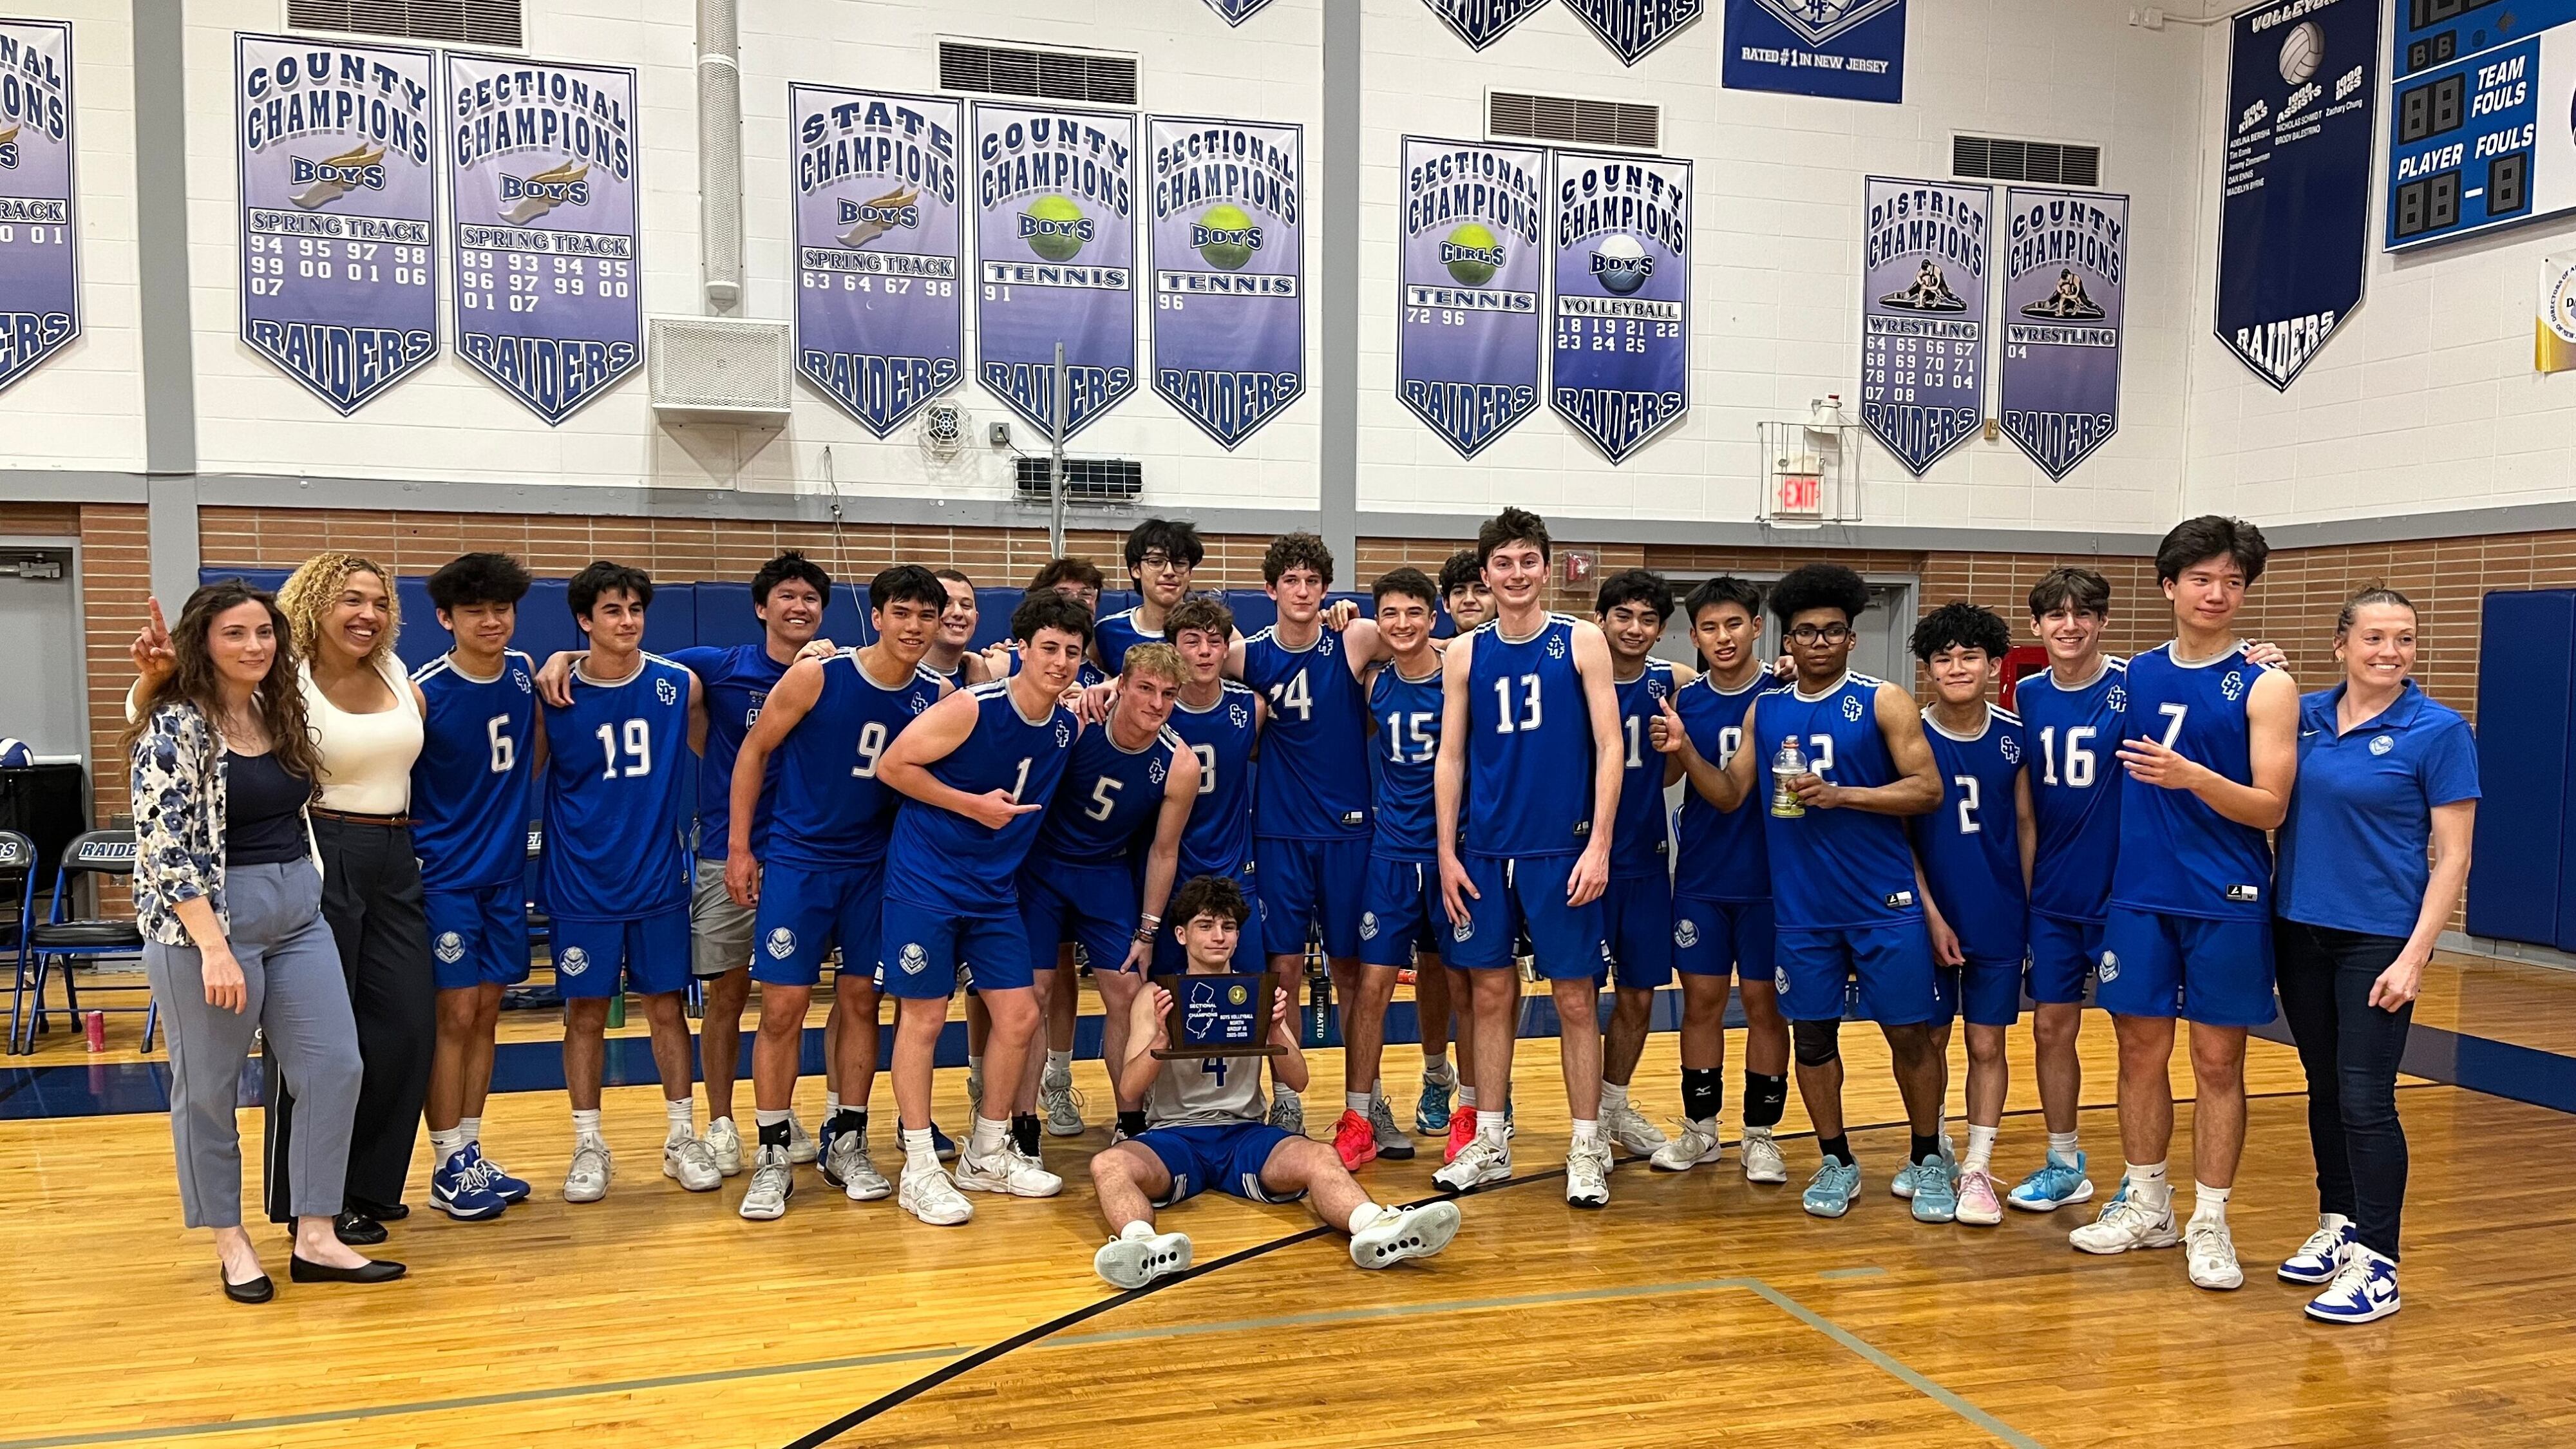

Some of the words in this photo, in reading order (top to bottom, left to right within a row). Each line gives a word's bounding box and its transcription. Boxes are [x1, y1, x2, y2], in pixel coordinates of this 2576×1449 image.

[1742, 47, 1778, 62] RATED
[1781, 48, 1797, 66] #1
[1799, 53, 1812, 66] IN
[1814, 54, 1843, 69] NEW
[1846, 57, 1888, 73] JERSEY
[2478, 55, 2525, 90] TEAM
[247, 52, 426, 111] COUNTY
[2289, 82, 2312, 106] 1000
[2336, 66, 2362, 90] 1000
[2336, 76, 2361, 100] DIGS
[458, 70, 627, 133] SECTIONAL
[2277, 86, 2322, 123] ASSISTS
[2472, 82, 2526, 117] FOULS
[247, 90, 427, 164] CHAMPIONS
[802, 102, 952, 159] STATE
[2239, 106, 2268, 133] KILLS
[457, 106, 630, 182] CHAMPIONS
[981, 118, 1128, 170] COUNTY
[1157, 129, 1294, 182] SECTIONAL
[2398, 144, 2463, 180] PLAYER
[2475, 124, 2534, 159] FOULS
[290, 156, 386, 190] BOYS
[800, 136, 955, 204] CHAMPIONS
[981, 151, 1128, 216] CHAMPIONS
[1411, 151, 1537, 203] SECTIONAL
[1562, 164, 1683, 210] COUNTY
[498, 172, 589, 206] BOYS
[1156, 164, 1296, 226] CHAMPIONS
[252, 211, 343, 236] SPRING
[345, 217, 426, 242] TRACK
[837, 198, 918, 229] BOYS
[1018, 212, 1094, 242] BOYS
[1408, 184, 1537, 245] CHAMPIONS
[1559, 196, 1683, 255] CHAMPIONS
[1871, 190, 1983, 236] DISTRICT
[2012, 200, 2121, 243] COUNTY
[31, 226, 62, 244] 01
[251, 236, 283, 254] 94
[299, 239, 330, 258] 95
[346, 243, 379, 261] 97
[394, 246, 426, 265] 98
[464, 227, 549, 250] SPRING
[554, 234, 629, 257] TRACK
[1190, 223, 1263, 251] BOYS
[1869, 220, 1982, 277] CHAMPIONS
[463, 251, 493, 269] 89
[508, 254, 538, 272] 93
[553, 258, 583, 276] 94
[599, 260, 627, 278] 95
[803, 249, 881, 272] SPRING
[884, 256, 952, 276] TRACK
[1439, 241, 1506, 267] GIRLS
[1589, 251, 1654, 277] BOYS
[2011, 230, 2119, 284] CHAMPIONS
[251, 258, 283, 276] 99
[299, 261, 331, 279] 00
[348, 264, 379, 283] 01
[395, 267, 426, 285] 06
[251, 278, 283, 296] 07
[464, 272, 493, 289] 96
[509, 274, 538, 292] 97
[554, 278, 583, 296] 99
[599, 280, 628, 298] 00
[803, 272, 829, 289] 63
[844, 275, 871, 292] 64
[886, 278, 911, 294] 67
[925, 281, 951, 297] 98
[989, 263, 1125, 287] TENNIS
[1162, 274, 1292, 294] TENNIS
[464, 292, 494, 310] 01
[509, 295, 538, 313] 07
[985, 285, 1010, 301] 91
[1159, 295, 1184, 310] 96
[1412, 288, 1532, 310] TENNIS
[1562, 298, 1678, 319] VOLLEYBALL
[1407, 308, 1430, 324] 72
[1442, 310, 1464, 326] 96
[1558, 317, 1581, 332] 18
[1593, 319, 1616, 334] 19
[1626, 321, 1644, 336] 21
[1656, 323, 1678, 337] 22
[1869, 317, 1976, 338] WRESTLING
[1558, 335, 1580, 349] 23
[1593, 336, 1615, 351] 24
[1626, 338, 1645, 353] 25
[1868, 336, 1886, 350] 64
[1897, 338, 1917, 352] 65
[1926, 340, 1944, 354] 66
[1955, 343, 1975, 355] 67
[2008, 345, 2027, 359] 04
[2011, 326, 2114, 345] WRESTLING
[2237, 310, 2334, 383] RAIDERS
[252, 319, 431, 403] RAIDERS
[464, 332, 634, 414] RAIDERS
[1867, 353, 1885, 366] 68
[1896, 355, 1915, 368] 69
[1926, 357, 1944, 370] 70
[1955, 359, 1973, 372] 71
[804, 350, 956, 427] RAIDERS
[1866, 369, 1885, 383] 78
[1895, 371, 1915, 384] 02
[1925, 373, 1944, 386] 03
[1953, 375, 1973, 389] 04
[1866, 386, 1884, 400] 07
[1895, 388, 1914, 402] 08
[1160, 369, 1298, 439] RAIDERS
[1405, 381, 1533, 449] RAIDERS
[1557, 388, 1681, 454] RAIDERS
[1865, 403, 1975, 466] RAIDERS
[2005, 411, 2112, 471] RAIDERS
[1785, 478, 1817, 507] EXIT
[1494, 674, 1541, 734] 13
[487, 713, 513, 773] 6
[1388, 711, 1434, 764] 15
[2159, 703, 2188, 750] 7
[596, 719, 651, 781] 19
[851, 721, 887, 779] 9
[2040, 726, 2096, 788] 16
[1012, 757, 1032, 804] 1
[1085, 775, 1124, 822] 5
[1955, 775, 1980, 834] 2
[1201, 1057, 1227, 1088] 4
